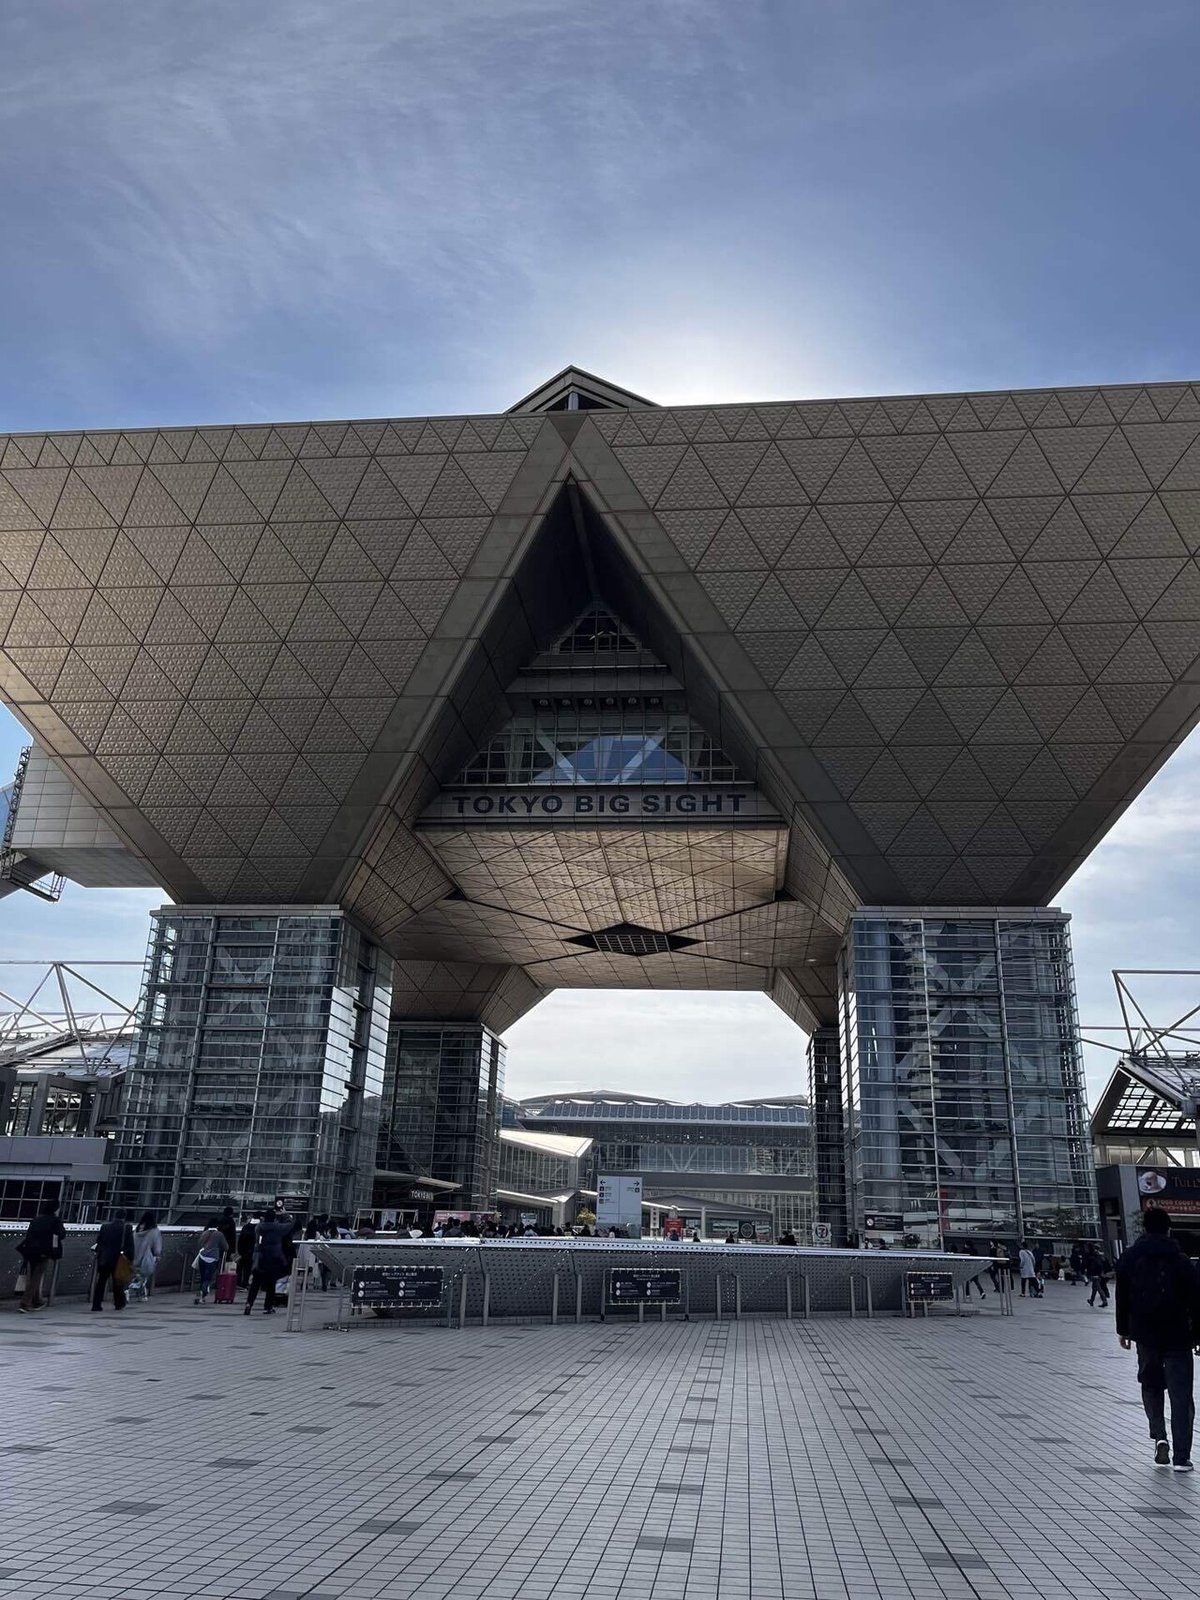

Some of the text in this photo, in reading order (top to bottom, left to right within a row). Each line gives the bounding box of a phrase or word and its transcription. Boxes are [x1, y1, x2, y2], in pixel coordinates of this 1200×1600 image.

[452, 794, 747, 814] TOKYO BIG SIGHT
